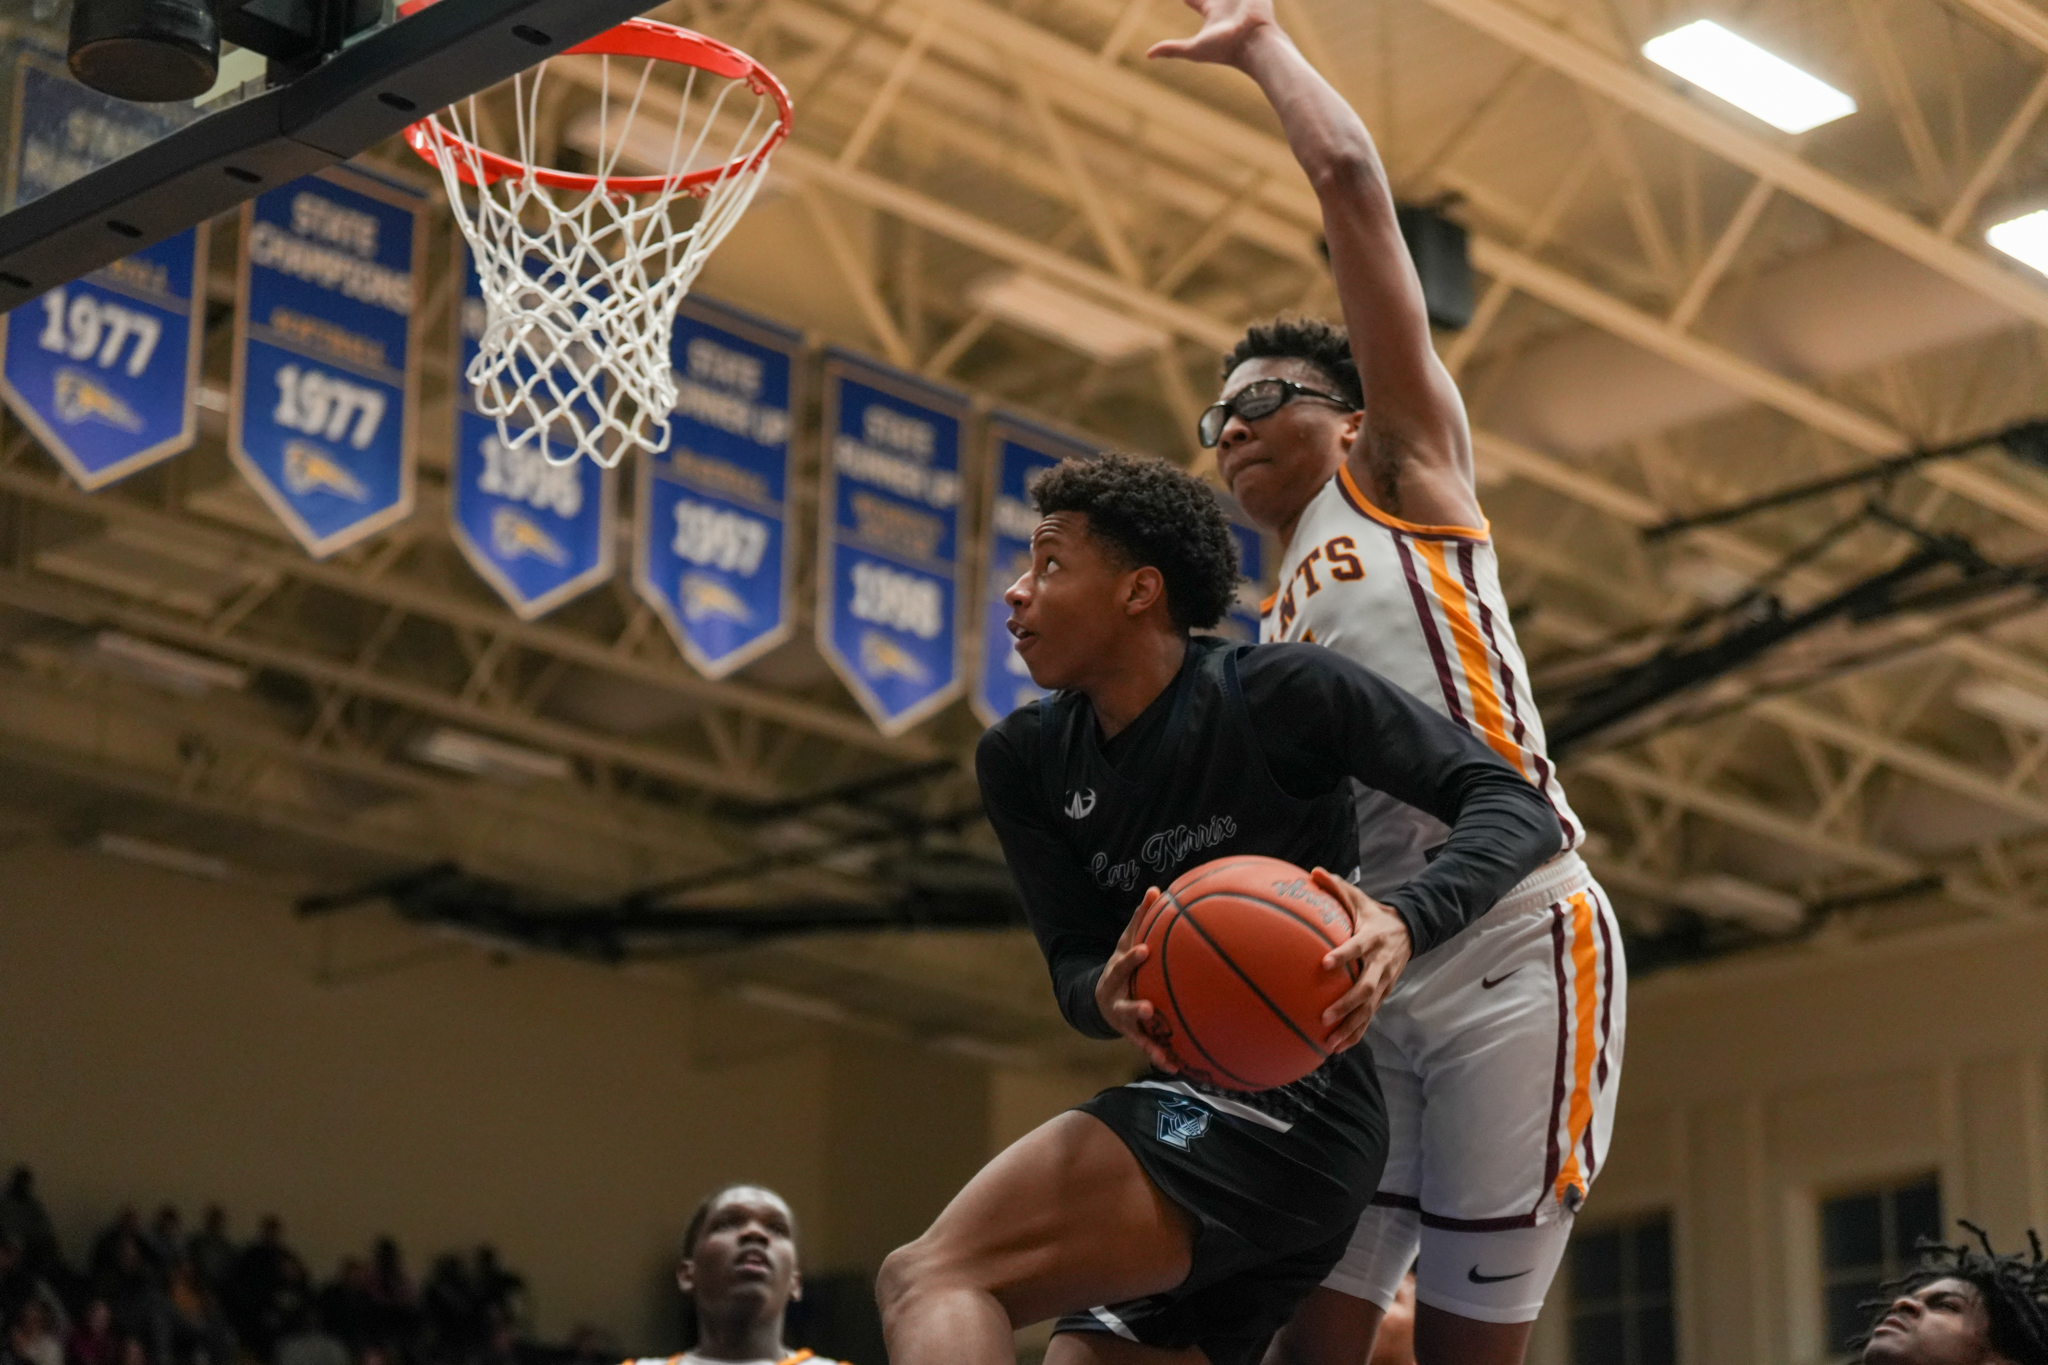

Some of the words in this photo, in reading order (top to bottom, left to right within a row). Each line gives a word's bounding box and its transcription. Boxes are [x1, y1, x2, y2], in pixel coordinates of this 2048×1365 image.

[39, 287, 162, 377] 1977
[272, 363, 386, 450] 1977
[1270, 535, 1366, 642] NTS
